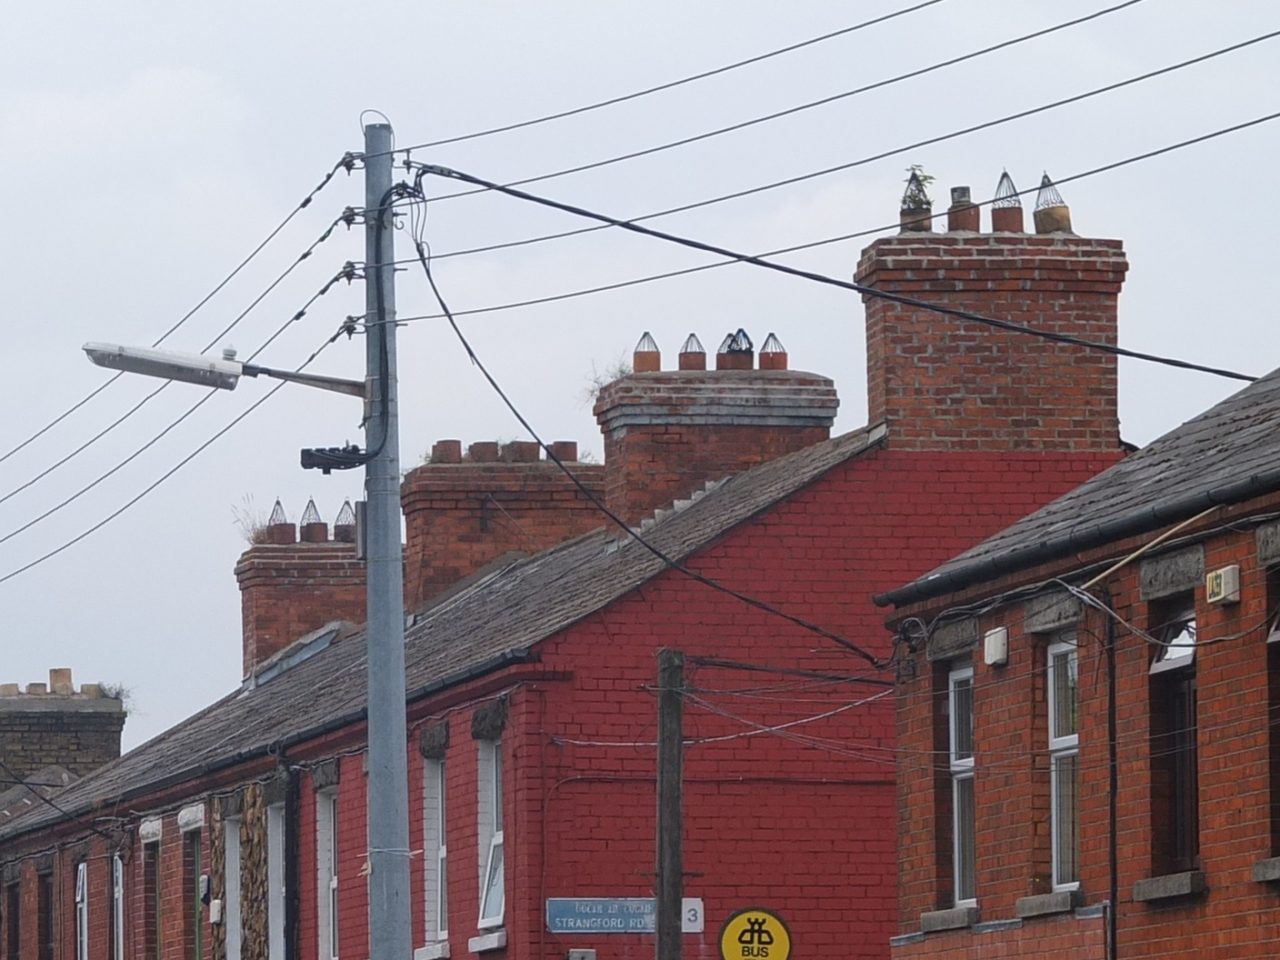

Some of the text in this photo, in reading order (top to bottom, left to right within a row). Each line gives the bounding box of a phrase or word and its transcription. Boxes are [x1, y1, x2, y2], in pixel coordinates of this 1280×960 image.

[687, 908, 699, 923] 3
[555, 917, 625, 929] STRANGFORD
[629, 917, 644, 929] RD
[741, 945, 769, 958] BUS
